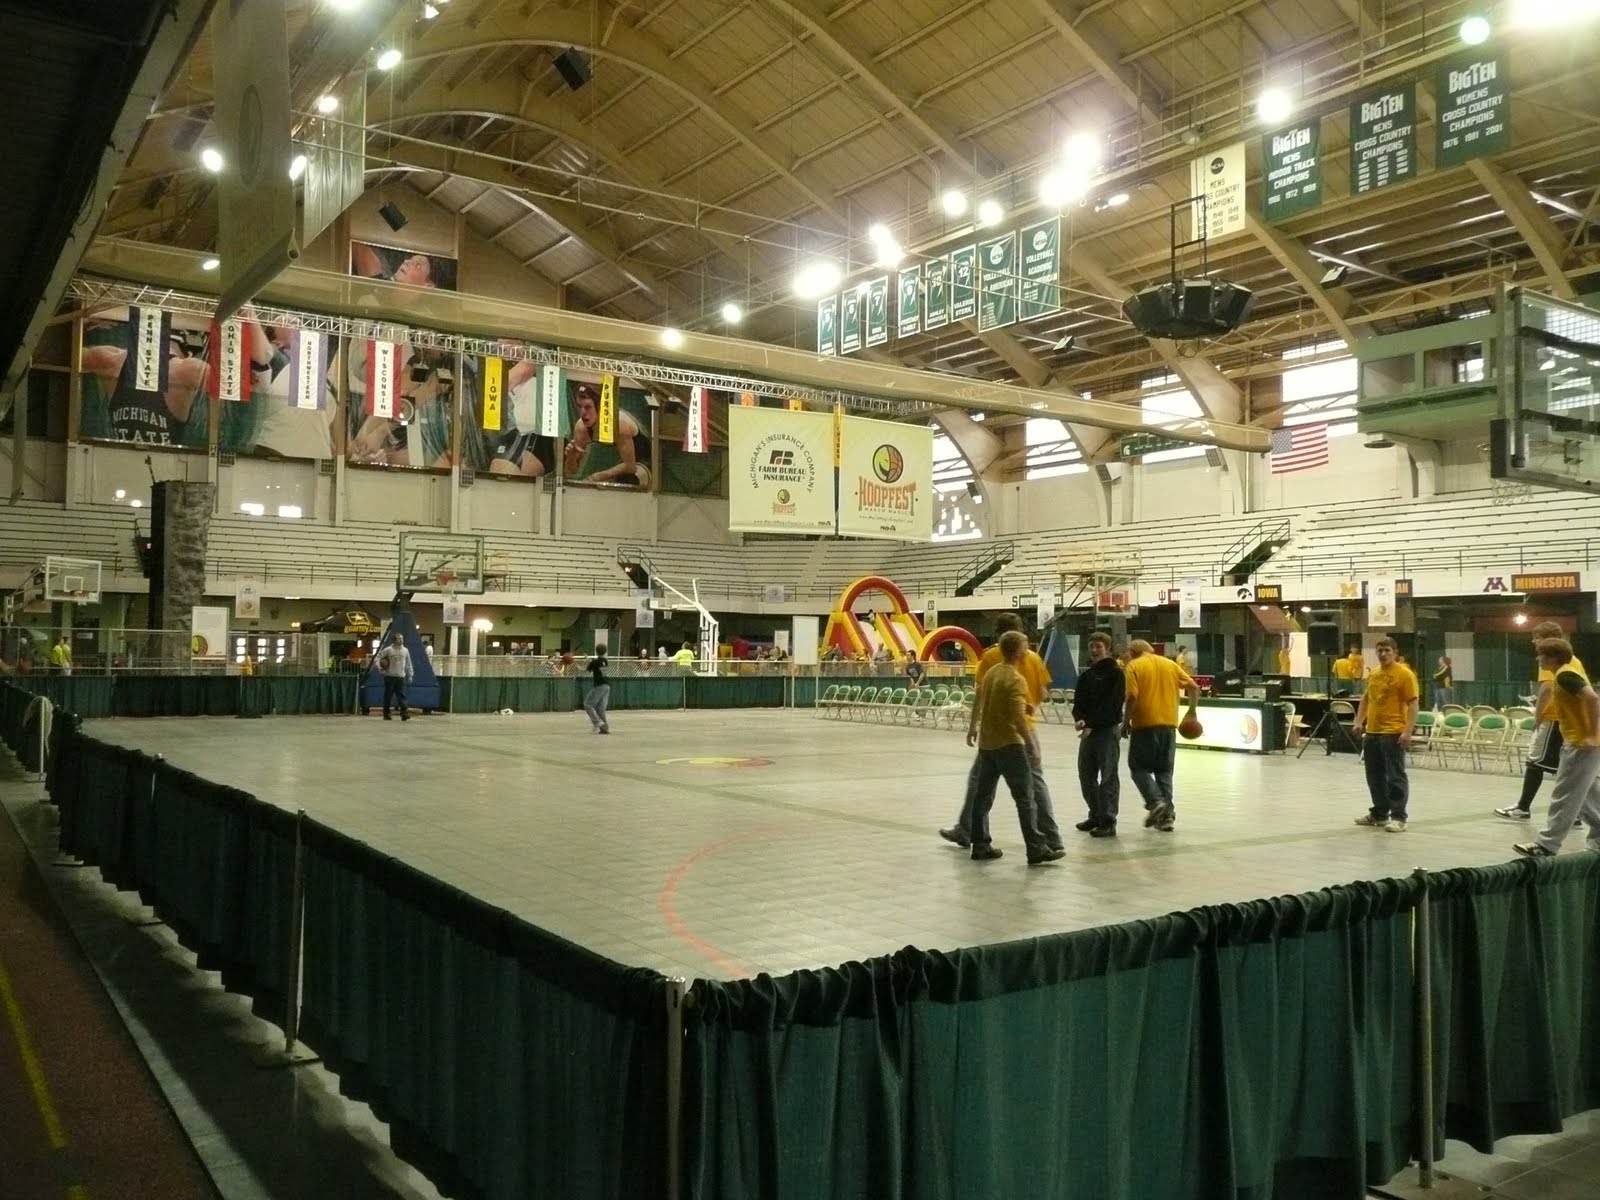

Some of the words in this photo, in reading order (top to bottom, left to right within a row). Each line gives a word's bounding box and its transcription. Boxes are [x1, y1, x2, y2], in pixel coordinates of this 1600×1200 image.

[1455, 86, 1489, 106] WOMENS
[1442, 106, 1467, 123] CROSS
[1468, 94, 1504, 114] COUNTRY
[1372, 119, 1393, 134] MENS
[1449, 109, 1495, 133] CHAMPIONS
[1354, 136, 1378, 151] CROSS
[1378, 125, 1412, 144] COUNTRY
[1362, 139, 1404, 161] CHAMPIONS
[1268, 165, 1292, 182] INDOOR
[1293, 157, 1316, 173] TRACK
[1273, 169, 1310, 190] CHAMPIONS
[1209, 178, 1226, 189] MENS
[1214, 183, 1240, 199] COUNTRY
[1201, 195, 1235, 214] CHAMPIONS
[958, 266, 969, 278] 12
[874, 295, 881, 306] 7
[145, 314, 154, 344] PENN
[227, 325, 235, 354] OHIO
[144, 349, 152, 386] STATE
[380, 349, 389, 410] WISCONSIN
[489, 376, 498, 411] IOWA
[112, 406, 168, 429] MICHIGAN
[758, 465, 778, 474] FARM
[778, 466, 807, 476] BUREAU
[766, 433, 805, 452] INSURANCE
[803, 449, 816, 494] COMPANY
[763, 473, 803, 483] INSURANCE
[858, 475, 917, 517] HOOPFEST
[1257, 587, 1279, 599] IOWA
[1514, 576, 1576, 590] MINNESOTA
